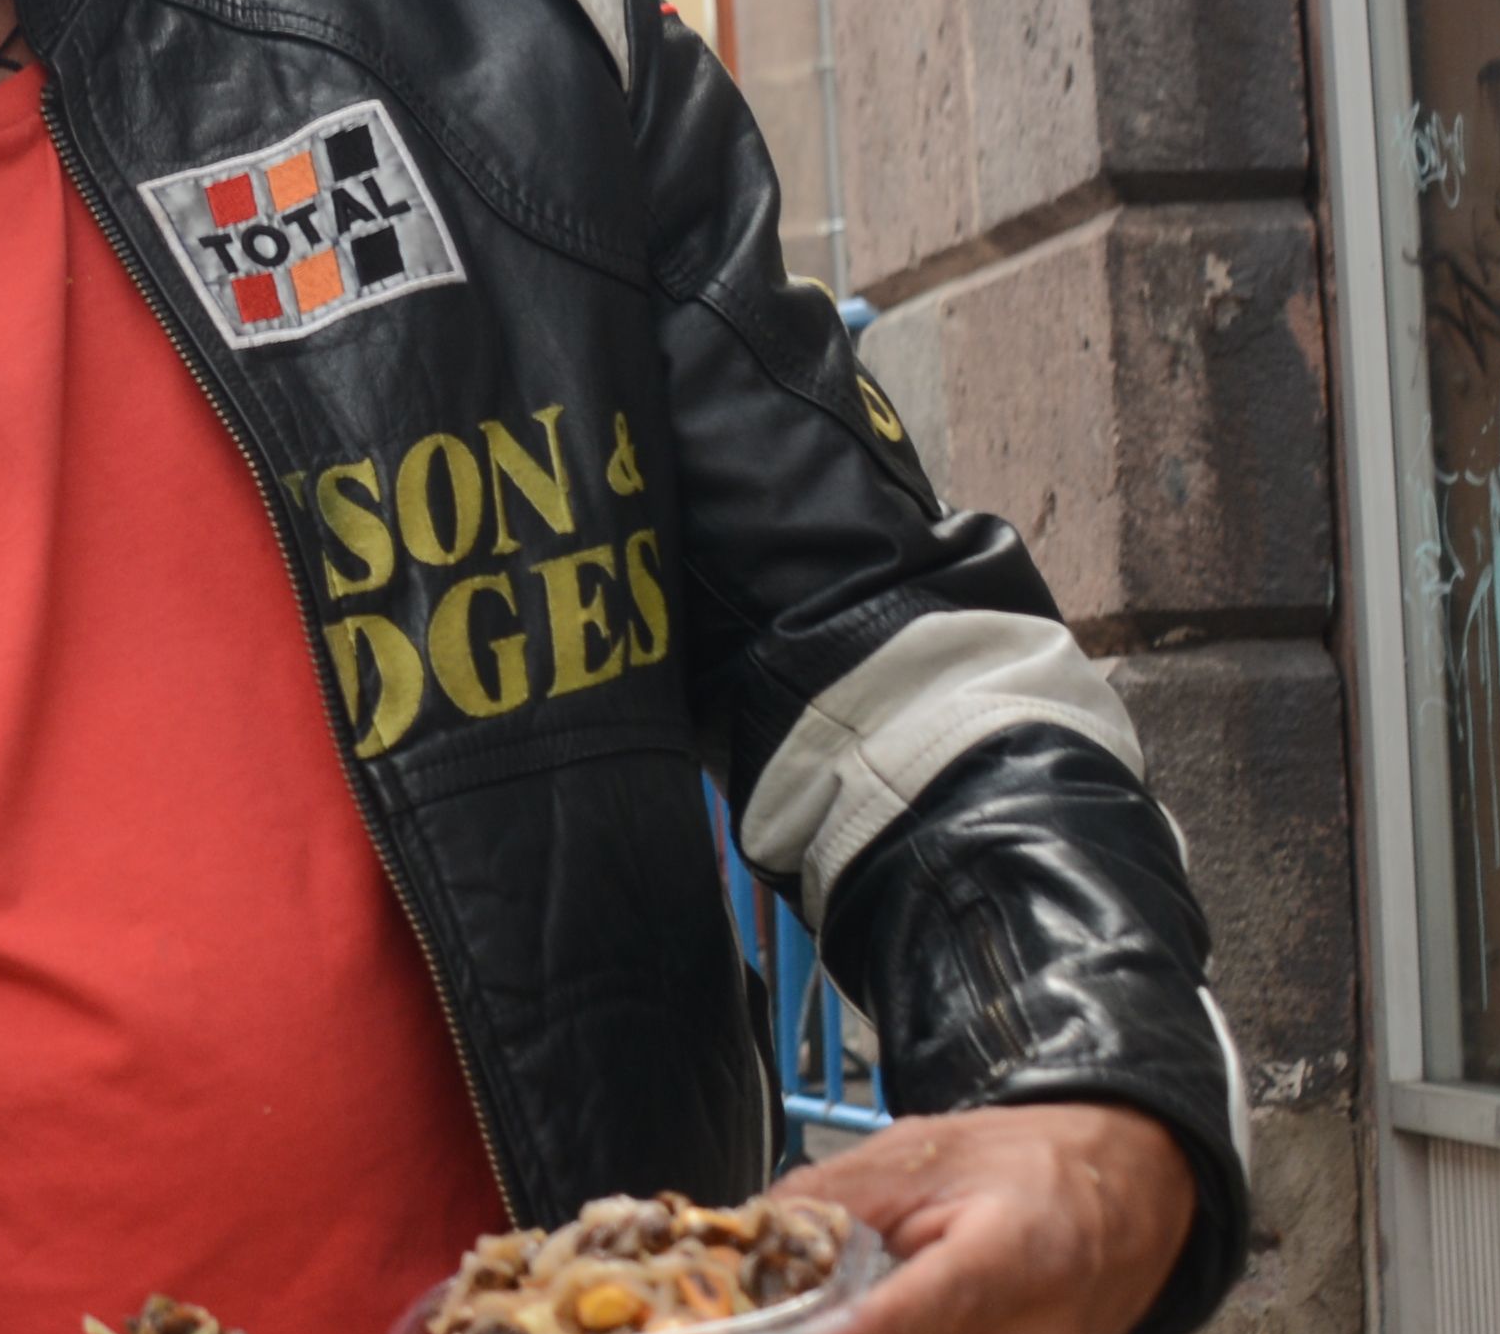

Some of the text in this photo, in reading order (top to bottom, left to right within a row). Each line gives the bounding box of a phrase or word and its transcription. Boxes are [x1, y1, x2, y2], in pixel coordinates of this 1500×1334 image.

[198, 176, 413, 274] TOTAL
[283, 403, 646, 601] SON &
[324, 528, 669, 760] DGES
